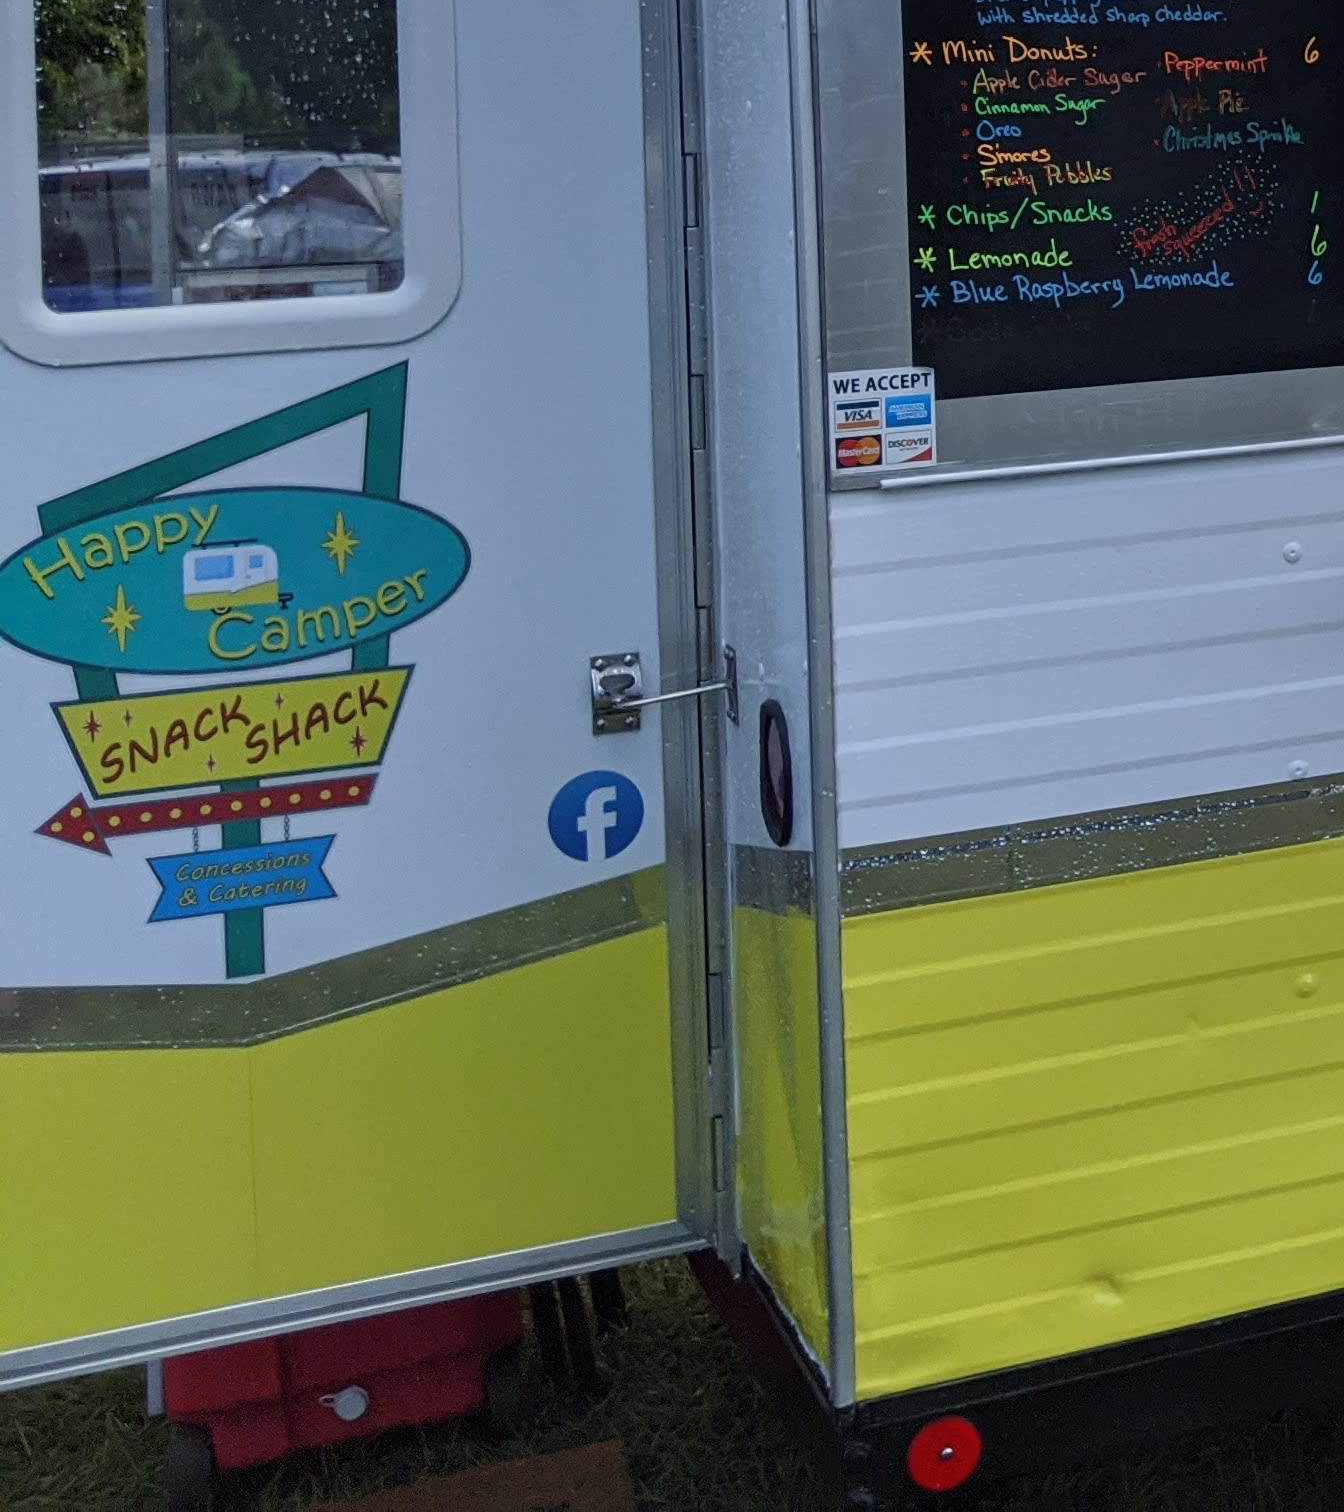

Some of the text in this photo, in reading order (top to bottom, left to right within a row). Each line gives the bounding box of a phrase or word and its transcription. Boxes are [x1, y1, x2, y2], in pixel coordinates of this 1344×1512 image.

[977, 5, 1015, 26] with
[1021, 2, 1099, 25] shredded
[1105, 6, 1150, 27] sharp
[941, 35, 1099, 65] Mini Donuts:
[1164, 49, 1269, 81] Peppermint
[1303, 36, 1320, 64] 6
[972, 67, 1147, 97] Apple Cider Sugar
[974, 93, 1107, 126] Cinnamon Sugar
[976, 120, 1023, 142] Oreo
[980, 161, 1113, 196] Fruity Pebbles
[946, 197, 1113, 233] Chips/Snacks
[1310, 191, 1320, 214] 1
[948, 238, 1074, 272] Lemonade
[1309, 224, 1327, 257] 6
[951, 259, 1235, 308] Blue Raspberry Lemonade
[1306, 259, 1323, 285] 6
[833, 372, 932, 394] WE ACCEPT
[844, 409, 873, 422] VISA
[887, 437, 929, 449] DISCOVER
[23, 503, 220, 600] Happy
[206, 567, 430, 660] Camper
[100, 679, 389, 785] SNACK SHACK
[175, 850, 312, 884] Concessions
[178, 872, 308, 907] & Catering
